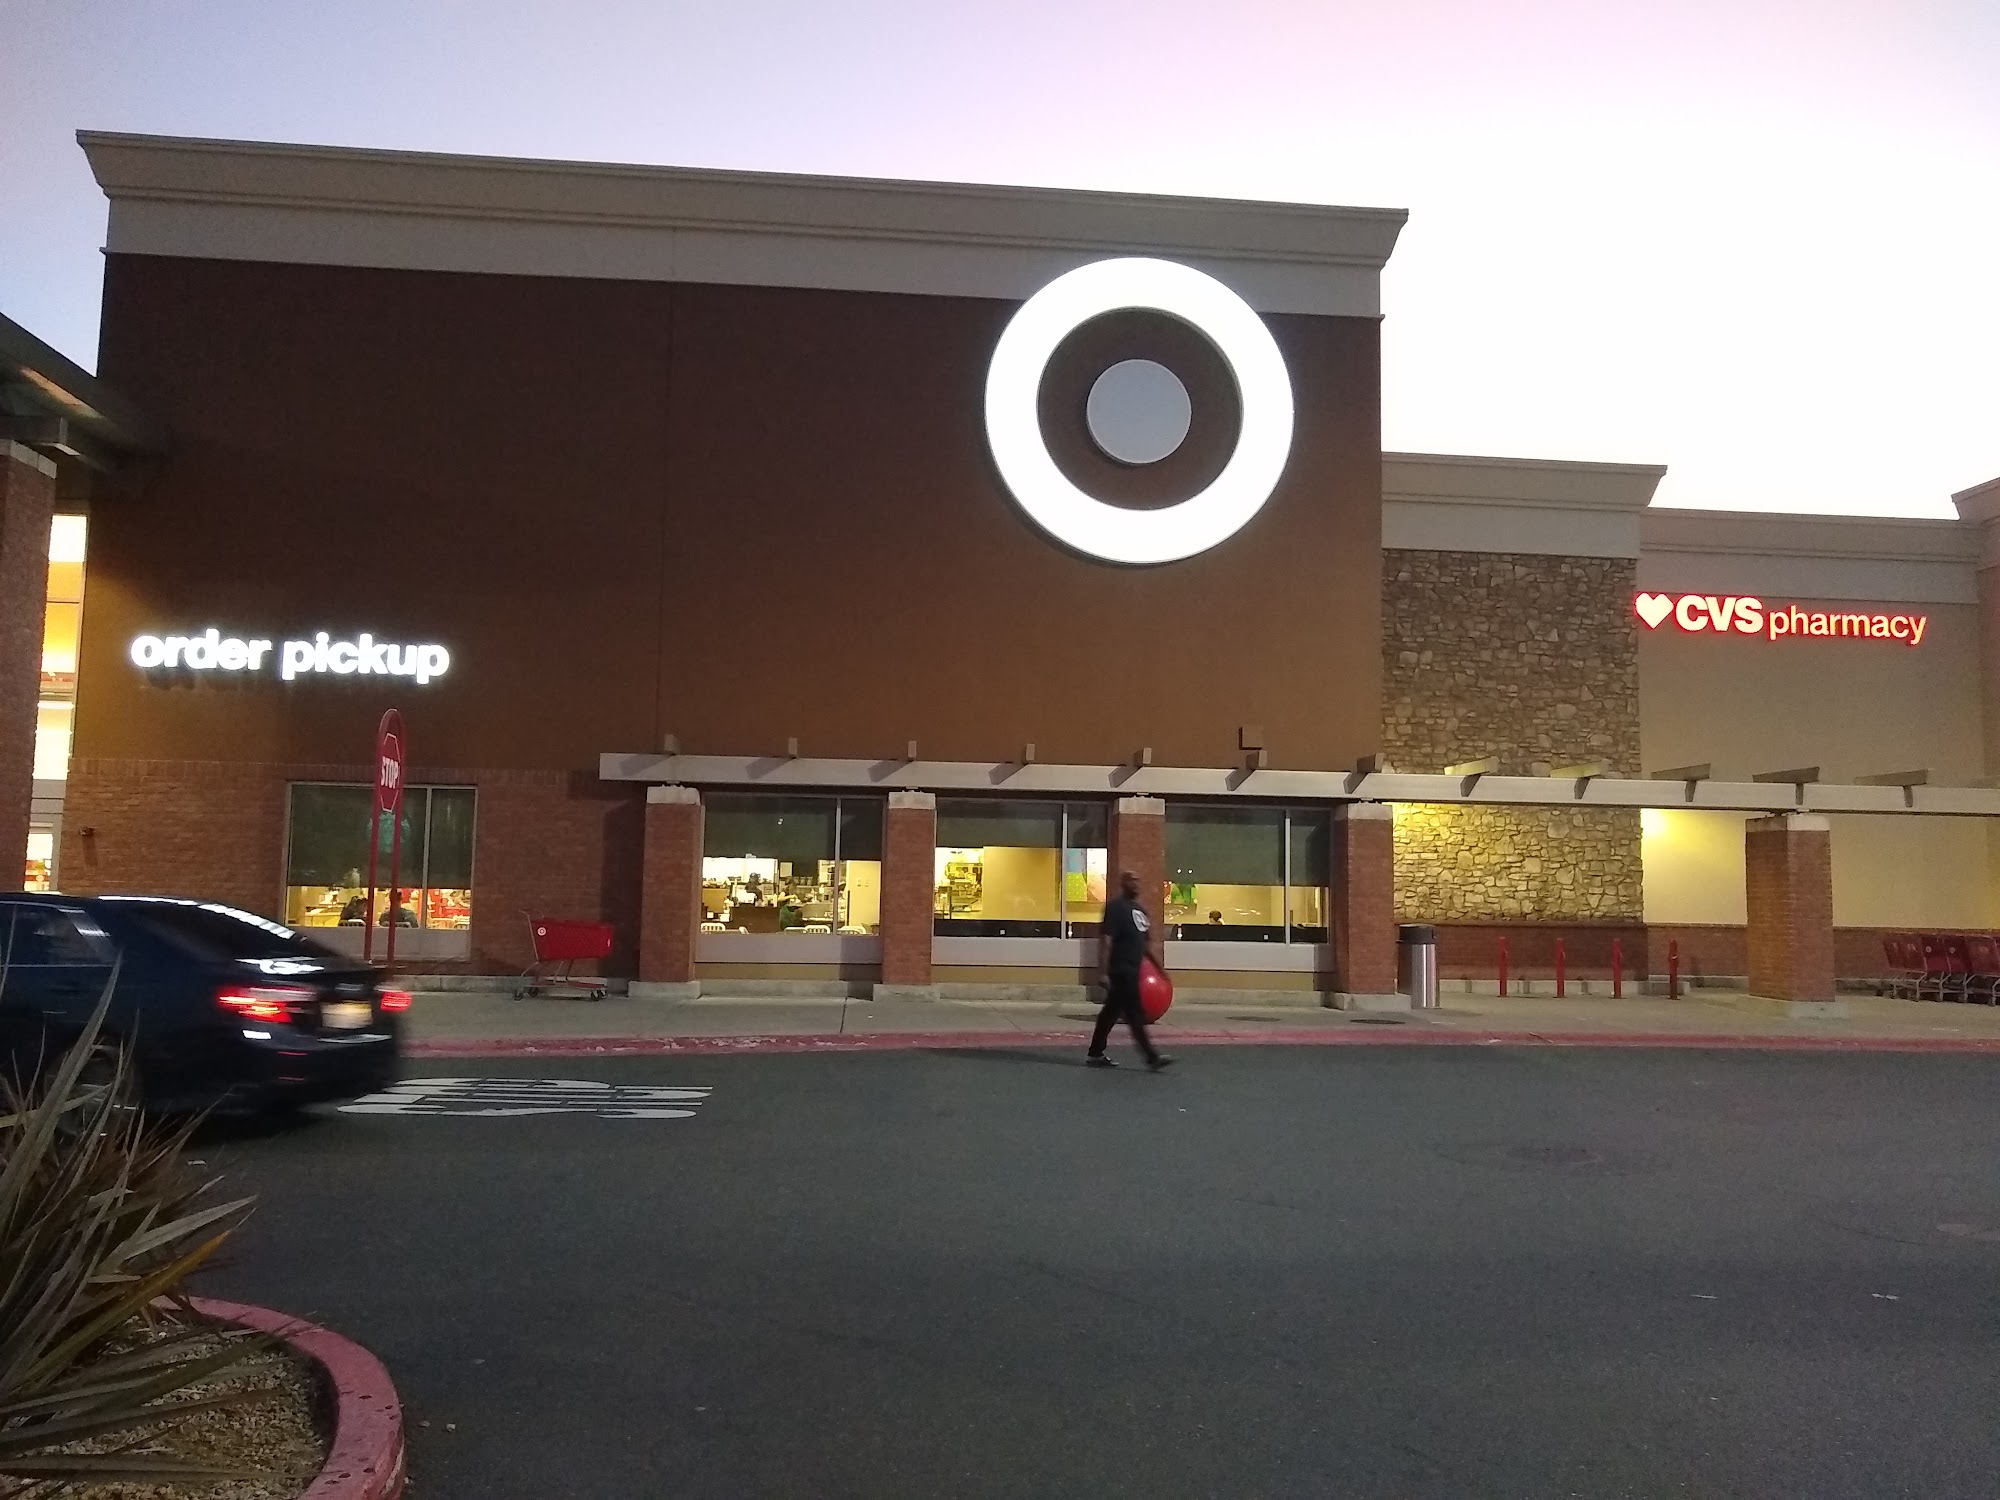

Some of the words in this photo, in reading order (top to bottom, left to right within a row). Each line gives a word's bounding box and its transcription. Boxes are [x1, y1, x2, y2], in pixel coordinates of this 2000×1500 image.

[1675, 595, 1764, 633] CVS
[1769, 605, 1927, 645] pharmacy
[130, 627, 273, 671] order
[280, 631, 451, 685] pickup
[380, 756, 399, 790] STOP
[337, 1077, 714, 1119] STOP
